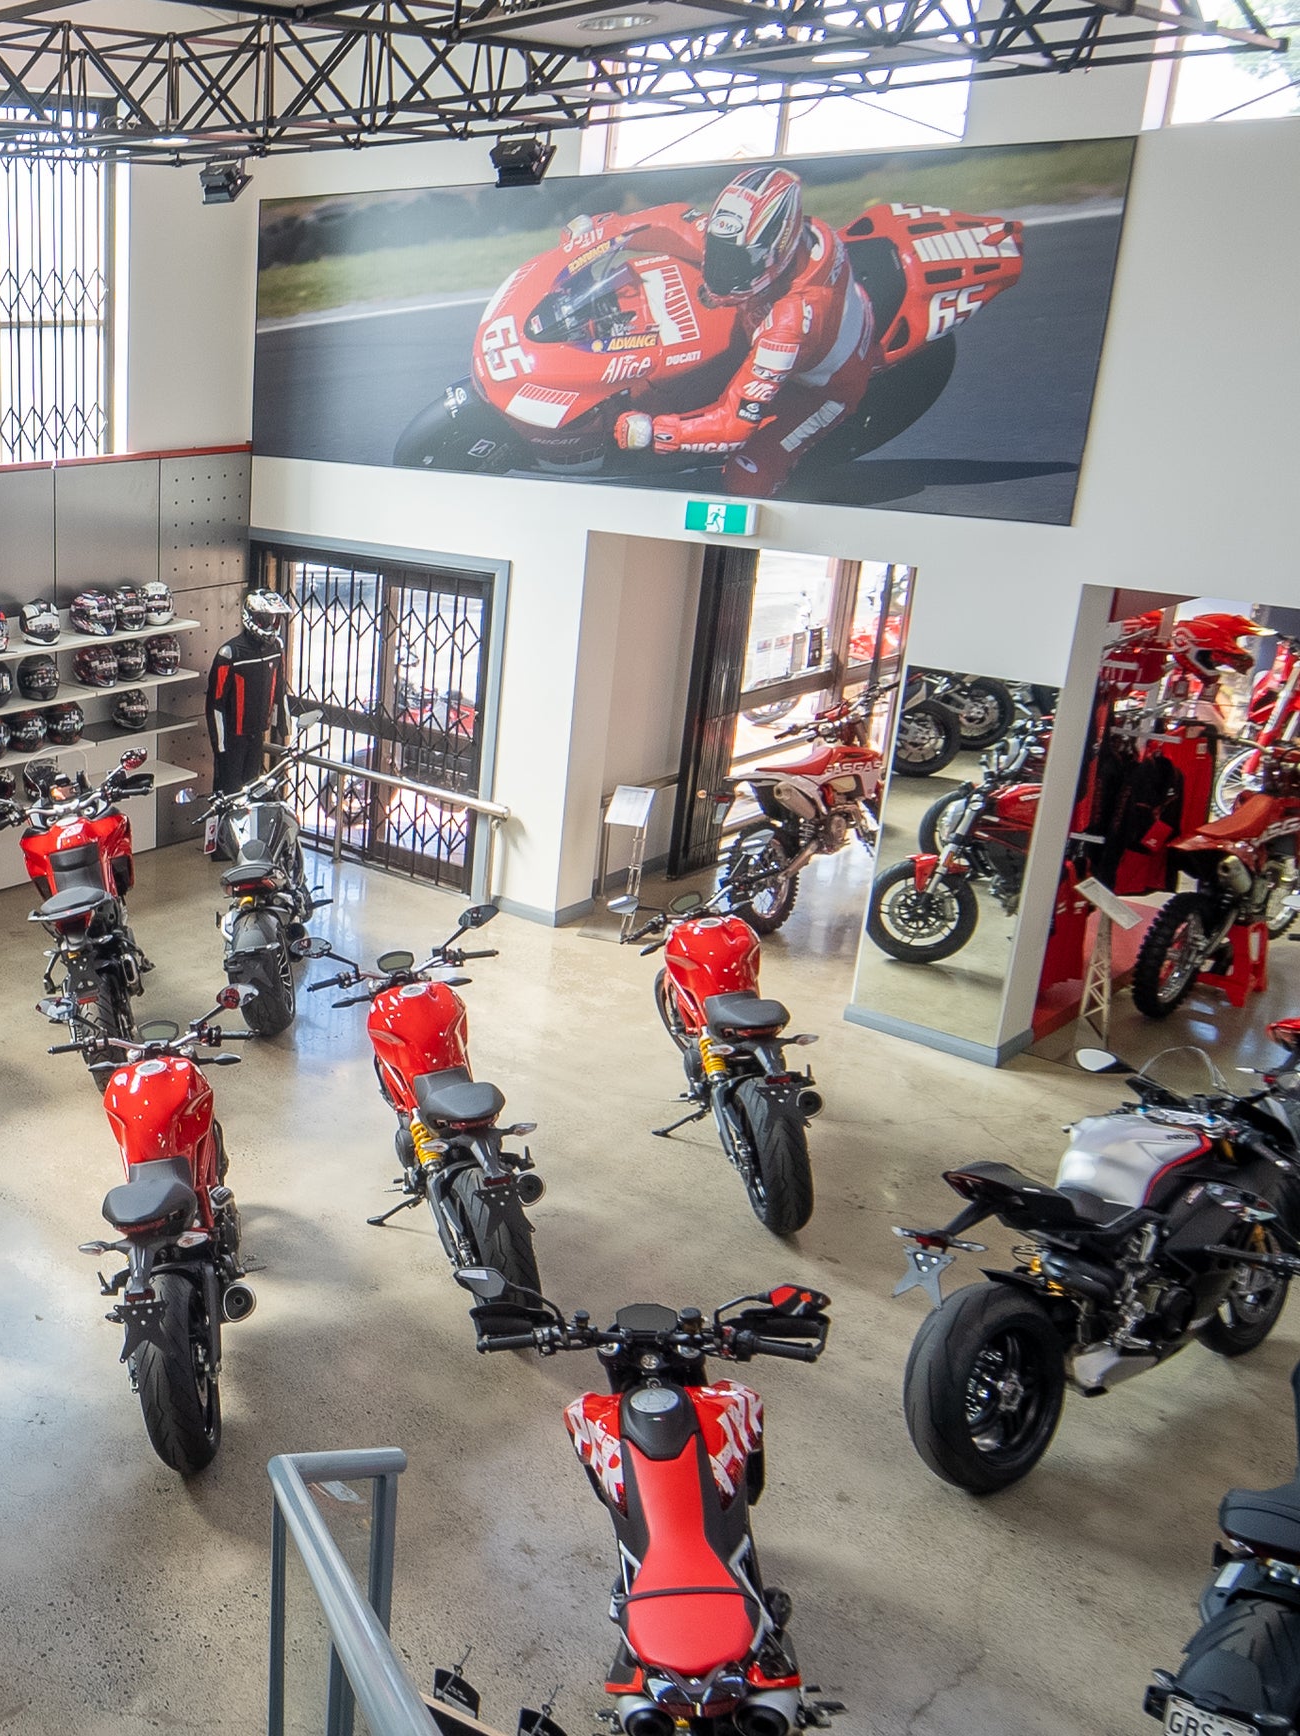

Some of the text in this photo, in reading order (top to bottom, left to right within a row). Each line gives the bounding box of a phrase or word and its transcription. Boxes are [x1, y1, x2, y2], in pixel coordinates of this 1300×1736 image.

[482, 315, 532, 381] 65
[666, 350, 701, 366] DUCATI
[601, 355, 651, 383] Alice
